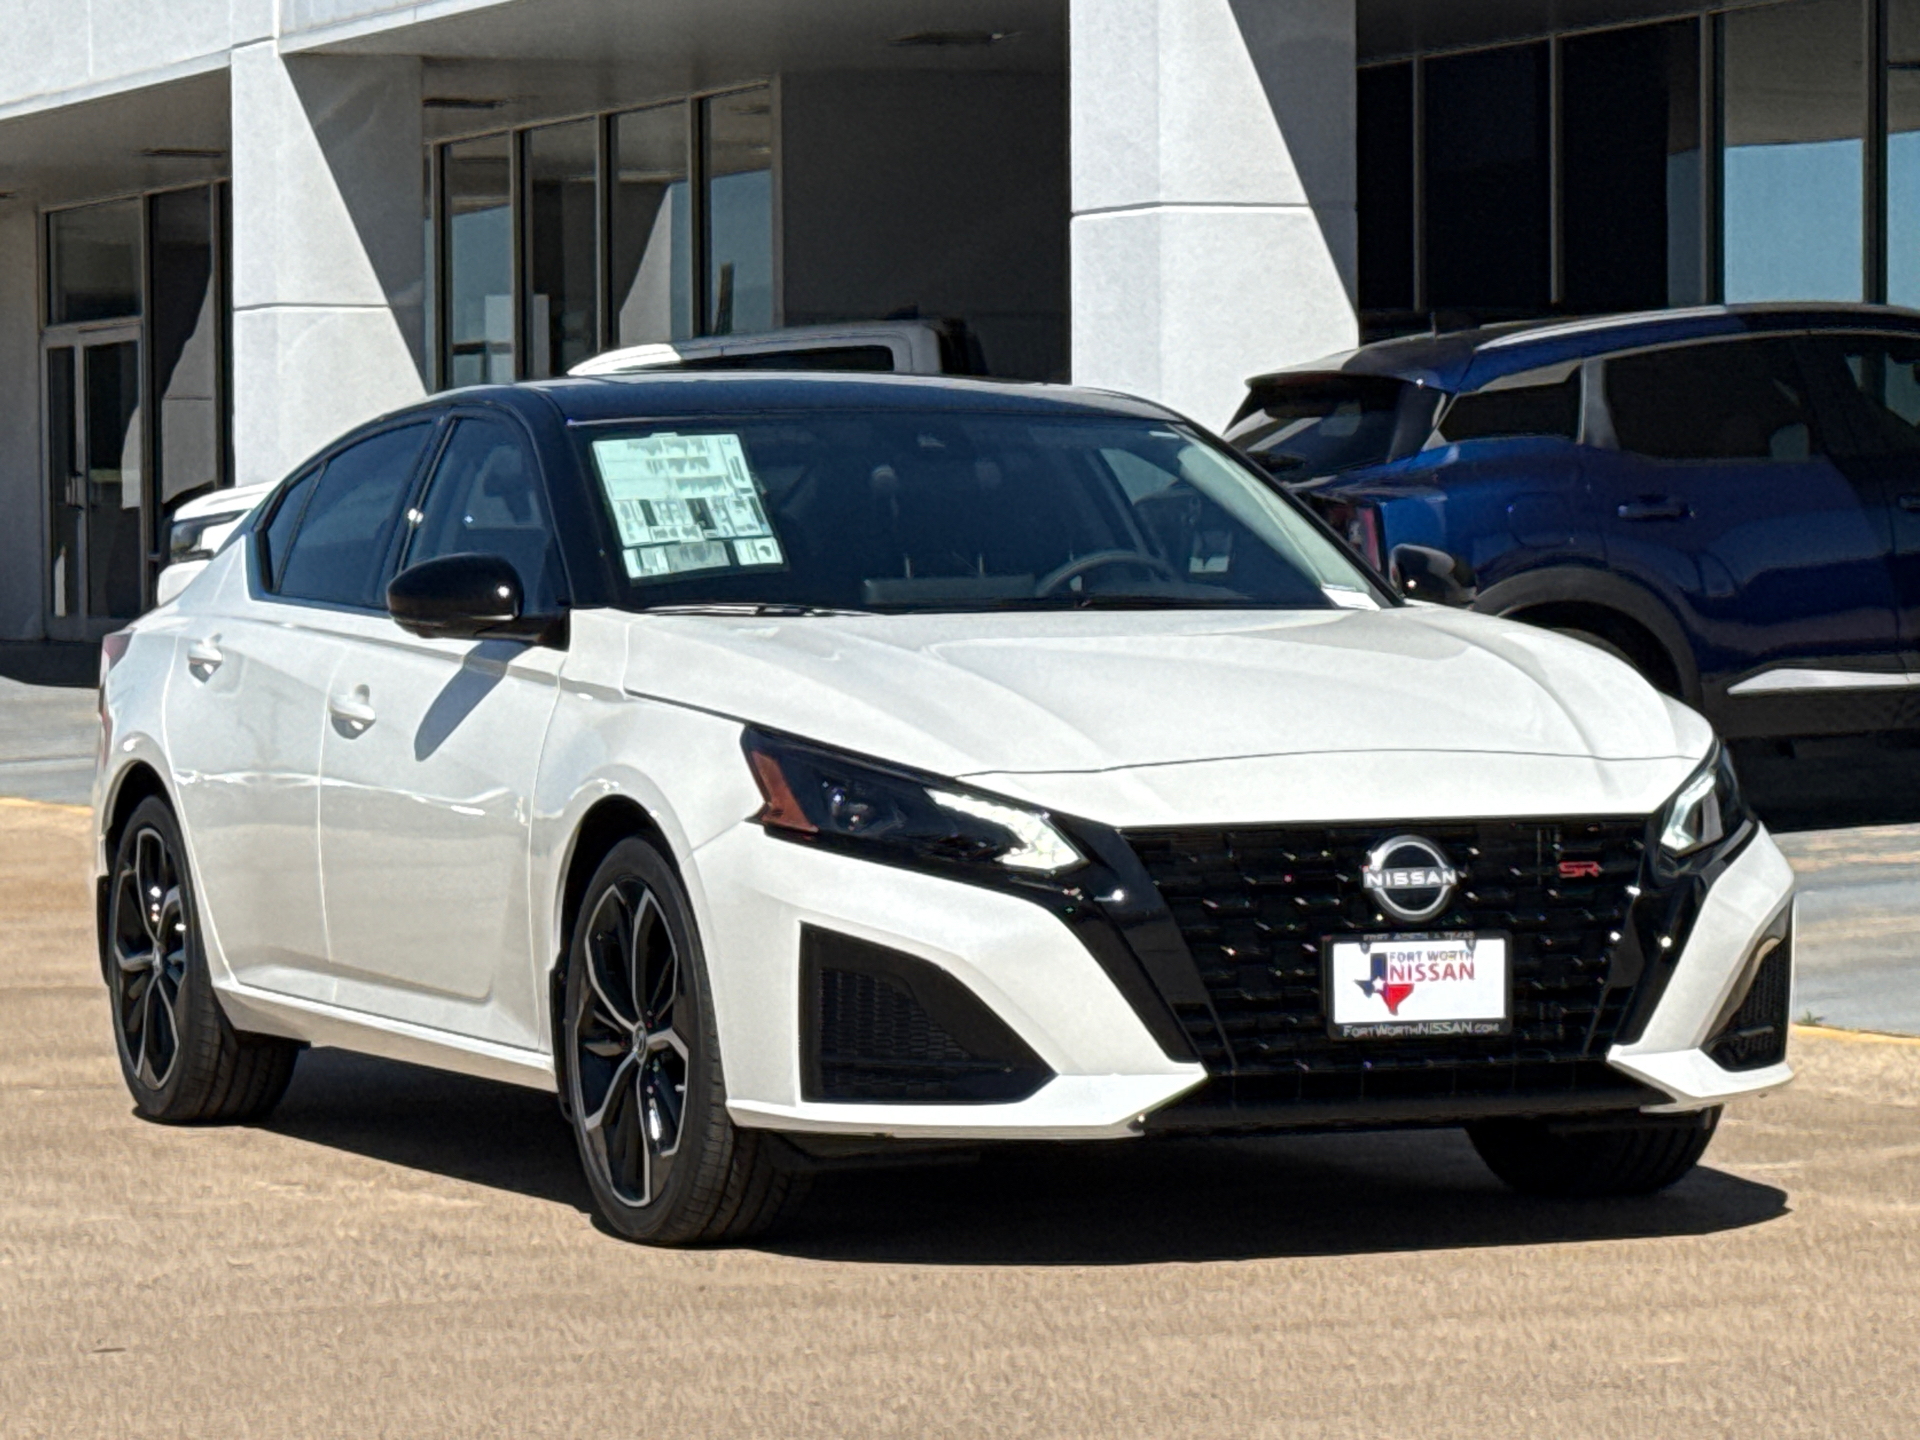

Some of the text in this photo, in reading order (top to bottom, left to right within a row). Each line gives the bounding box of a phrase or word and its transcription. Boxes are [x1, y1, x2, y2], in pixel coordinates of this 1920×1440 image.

[1366, 869, 1458, 886] NISSAN
[1559, 861, 1600, 878] SR
[1389, 950, 1475, 962] FORT WORTH
[1389, 962, 1475, 982] NISSAN
